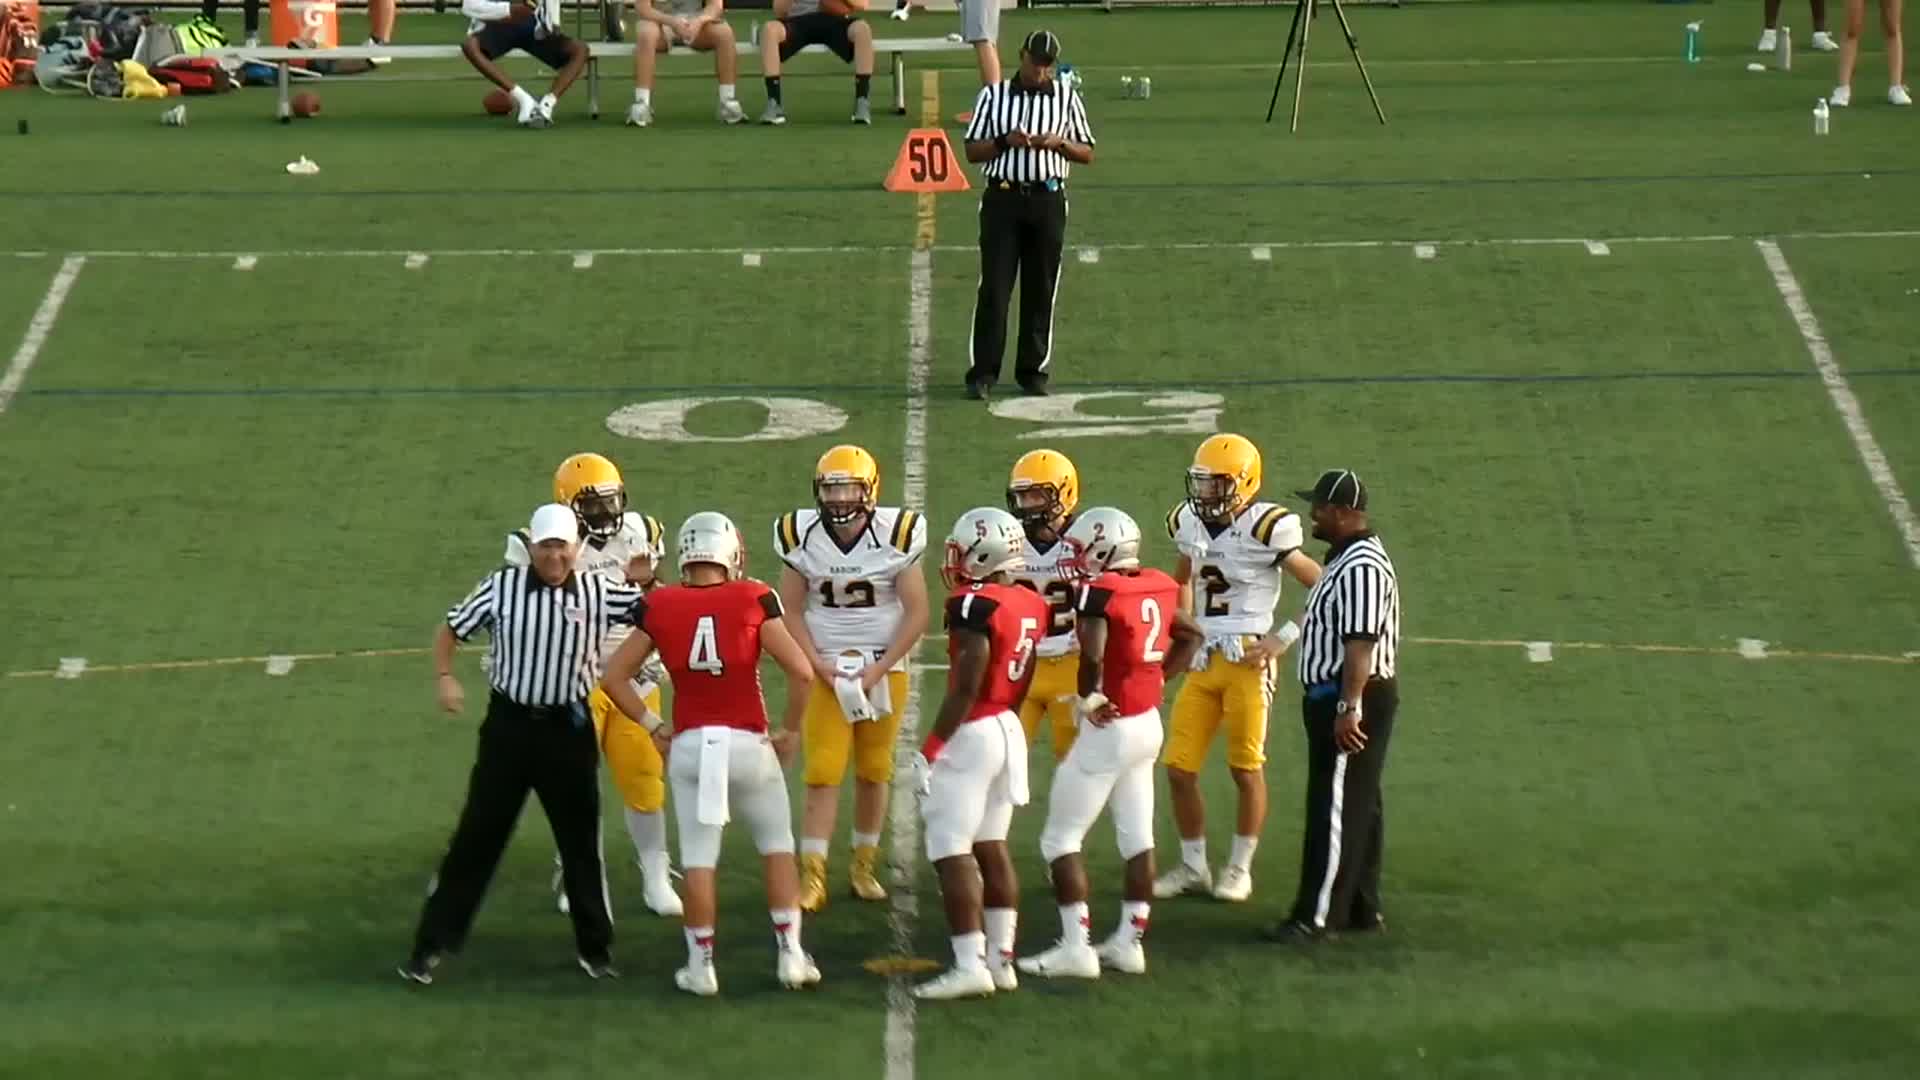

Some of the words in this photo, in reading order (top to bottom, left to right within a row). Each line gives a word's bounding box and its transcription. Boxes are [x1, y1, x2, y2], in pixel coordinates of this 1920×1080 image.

[909, 138, 948, 183] 50
[975, 520, 988, 539] 5
[1094, 522, 1106, 542] 2
[1200, 564, 1231, 617] 2
[688, 615, 724, 677] 4
[1007, 617, 1038, 681] 5
[1141, 597, 1165, 664] 2
